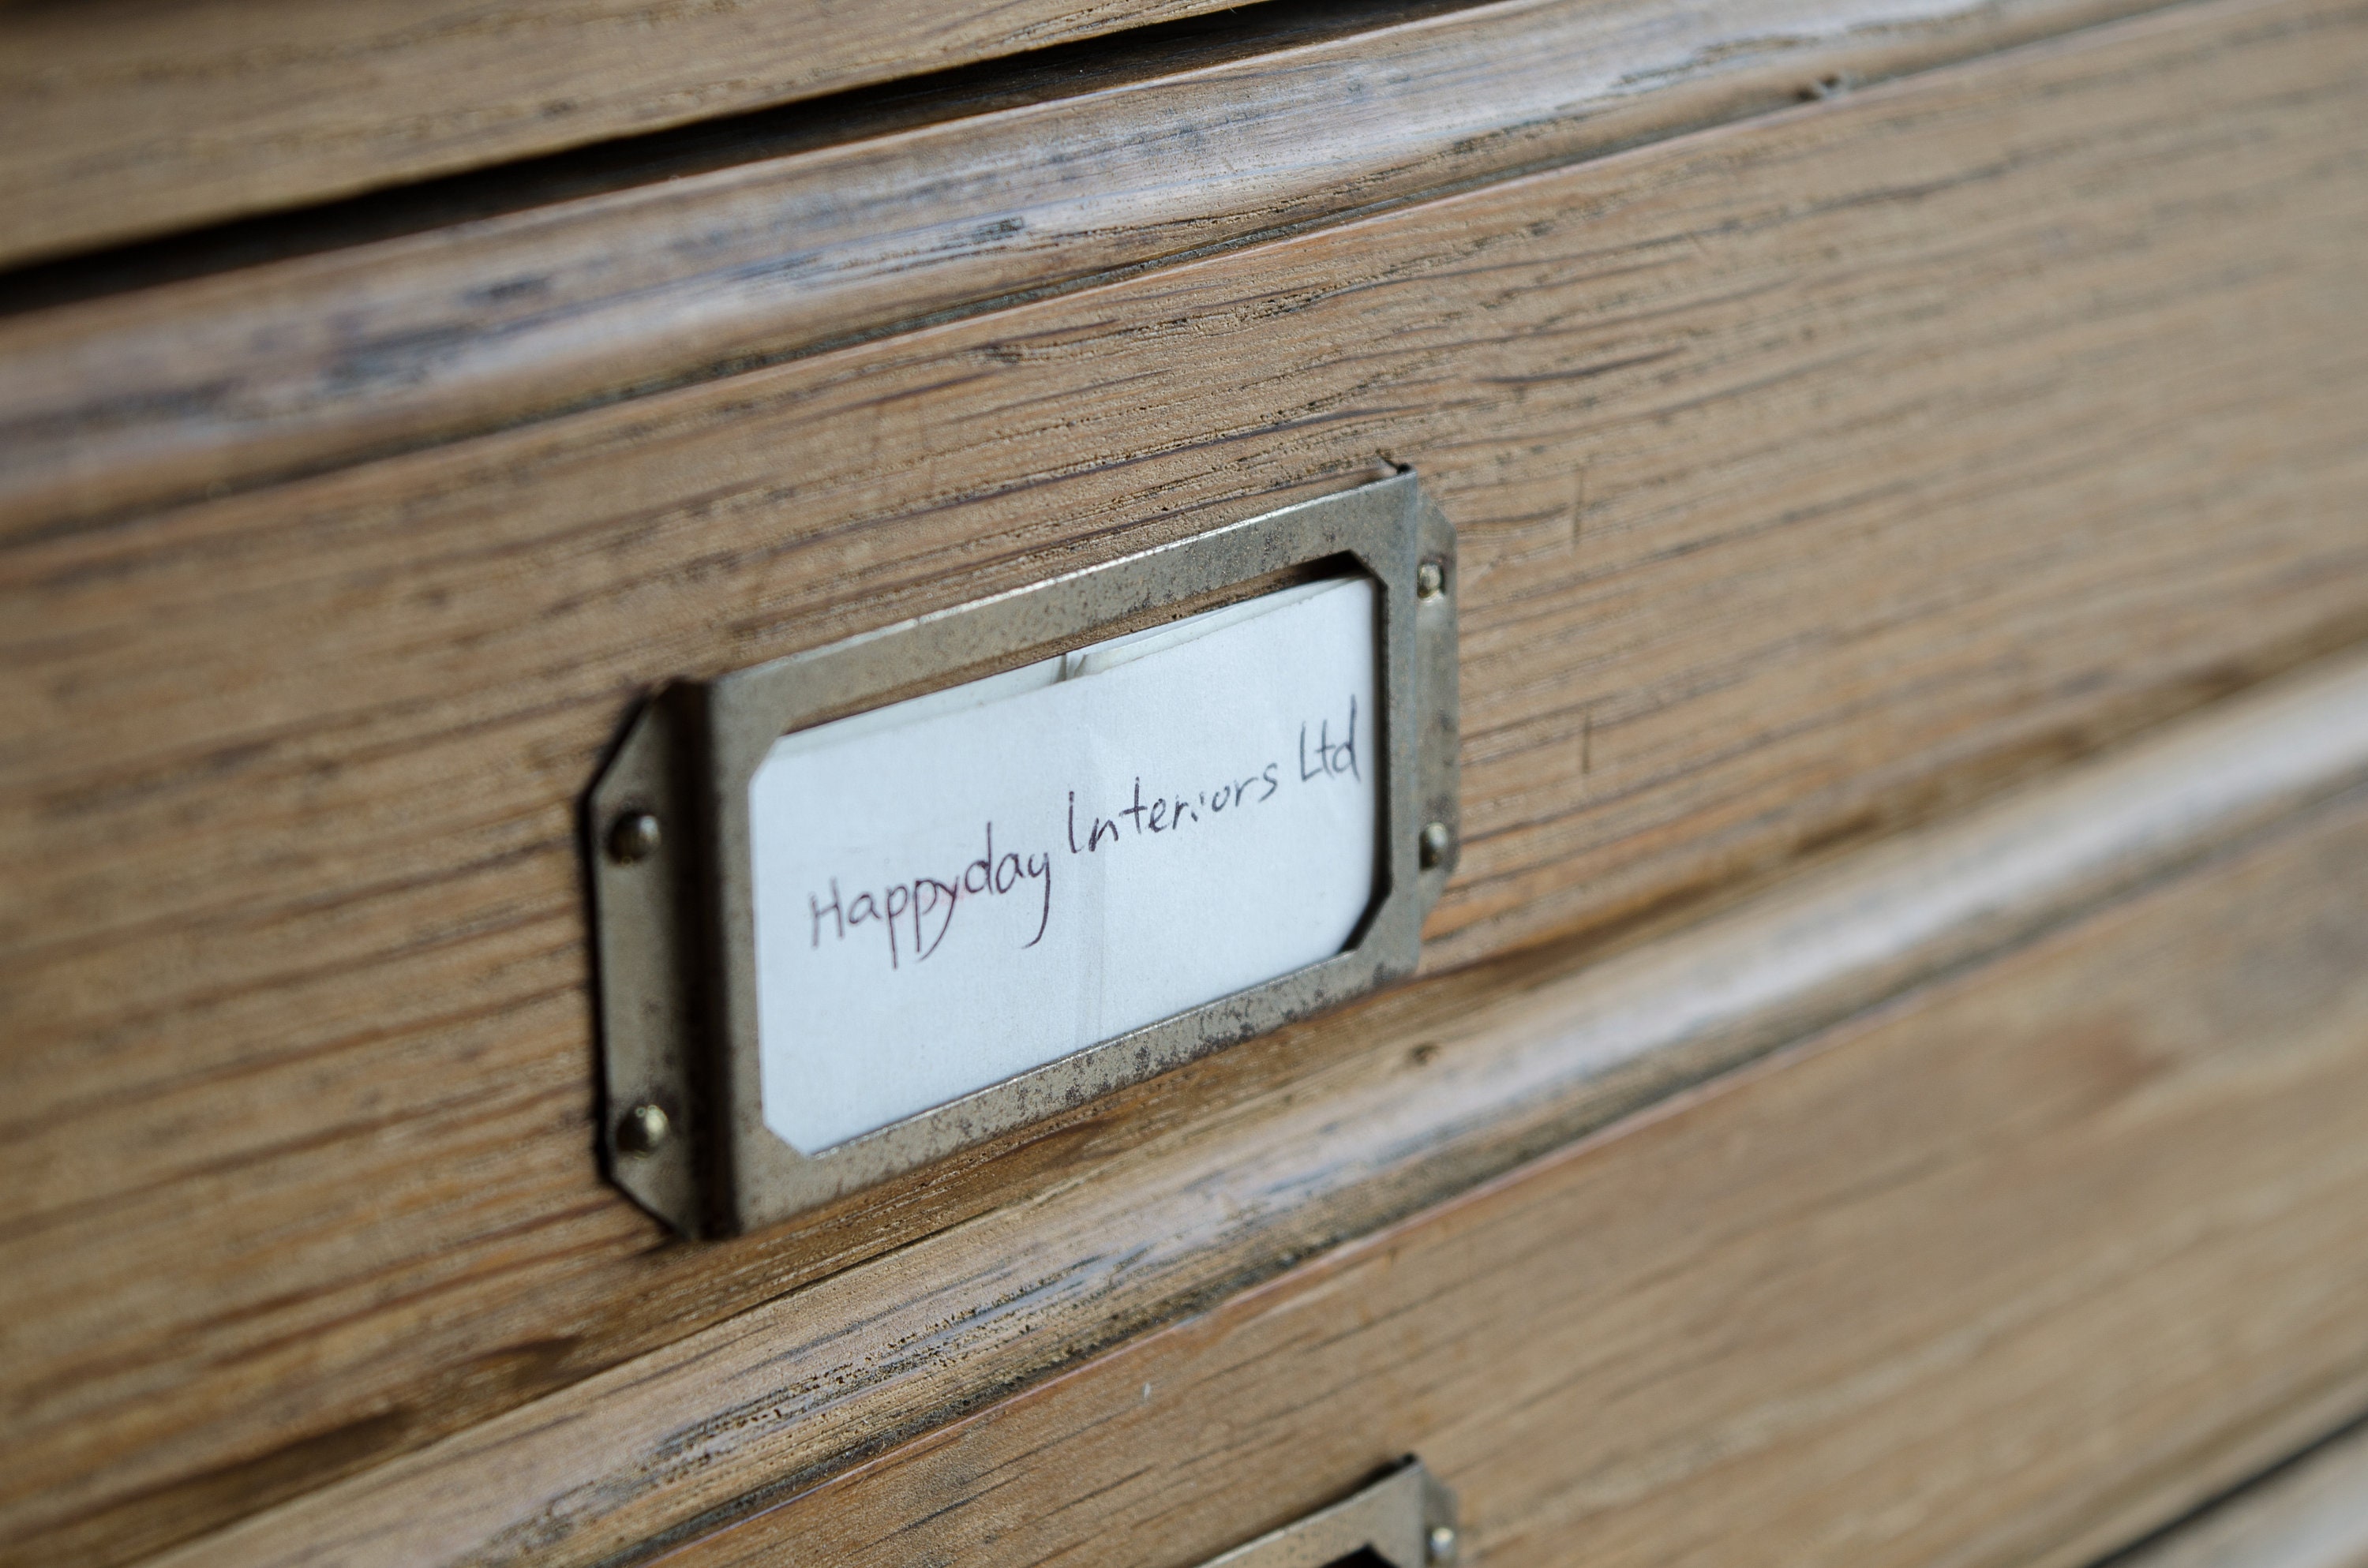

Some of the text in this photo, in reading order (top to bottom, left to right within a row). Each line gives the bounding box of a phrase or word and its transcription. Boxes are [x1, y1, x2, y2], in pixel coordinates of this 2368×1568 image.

[810, 694, 1360, 970] Happyday Interiors Ltd
